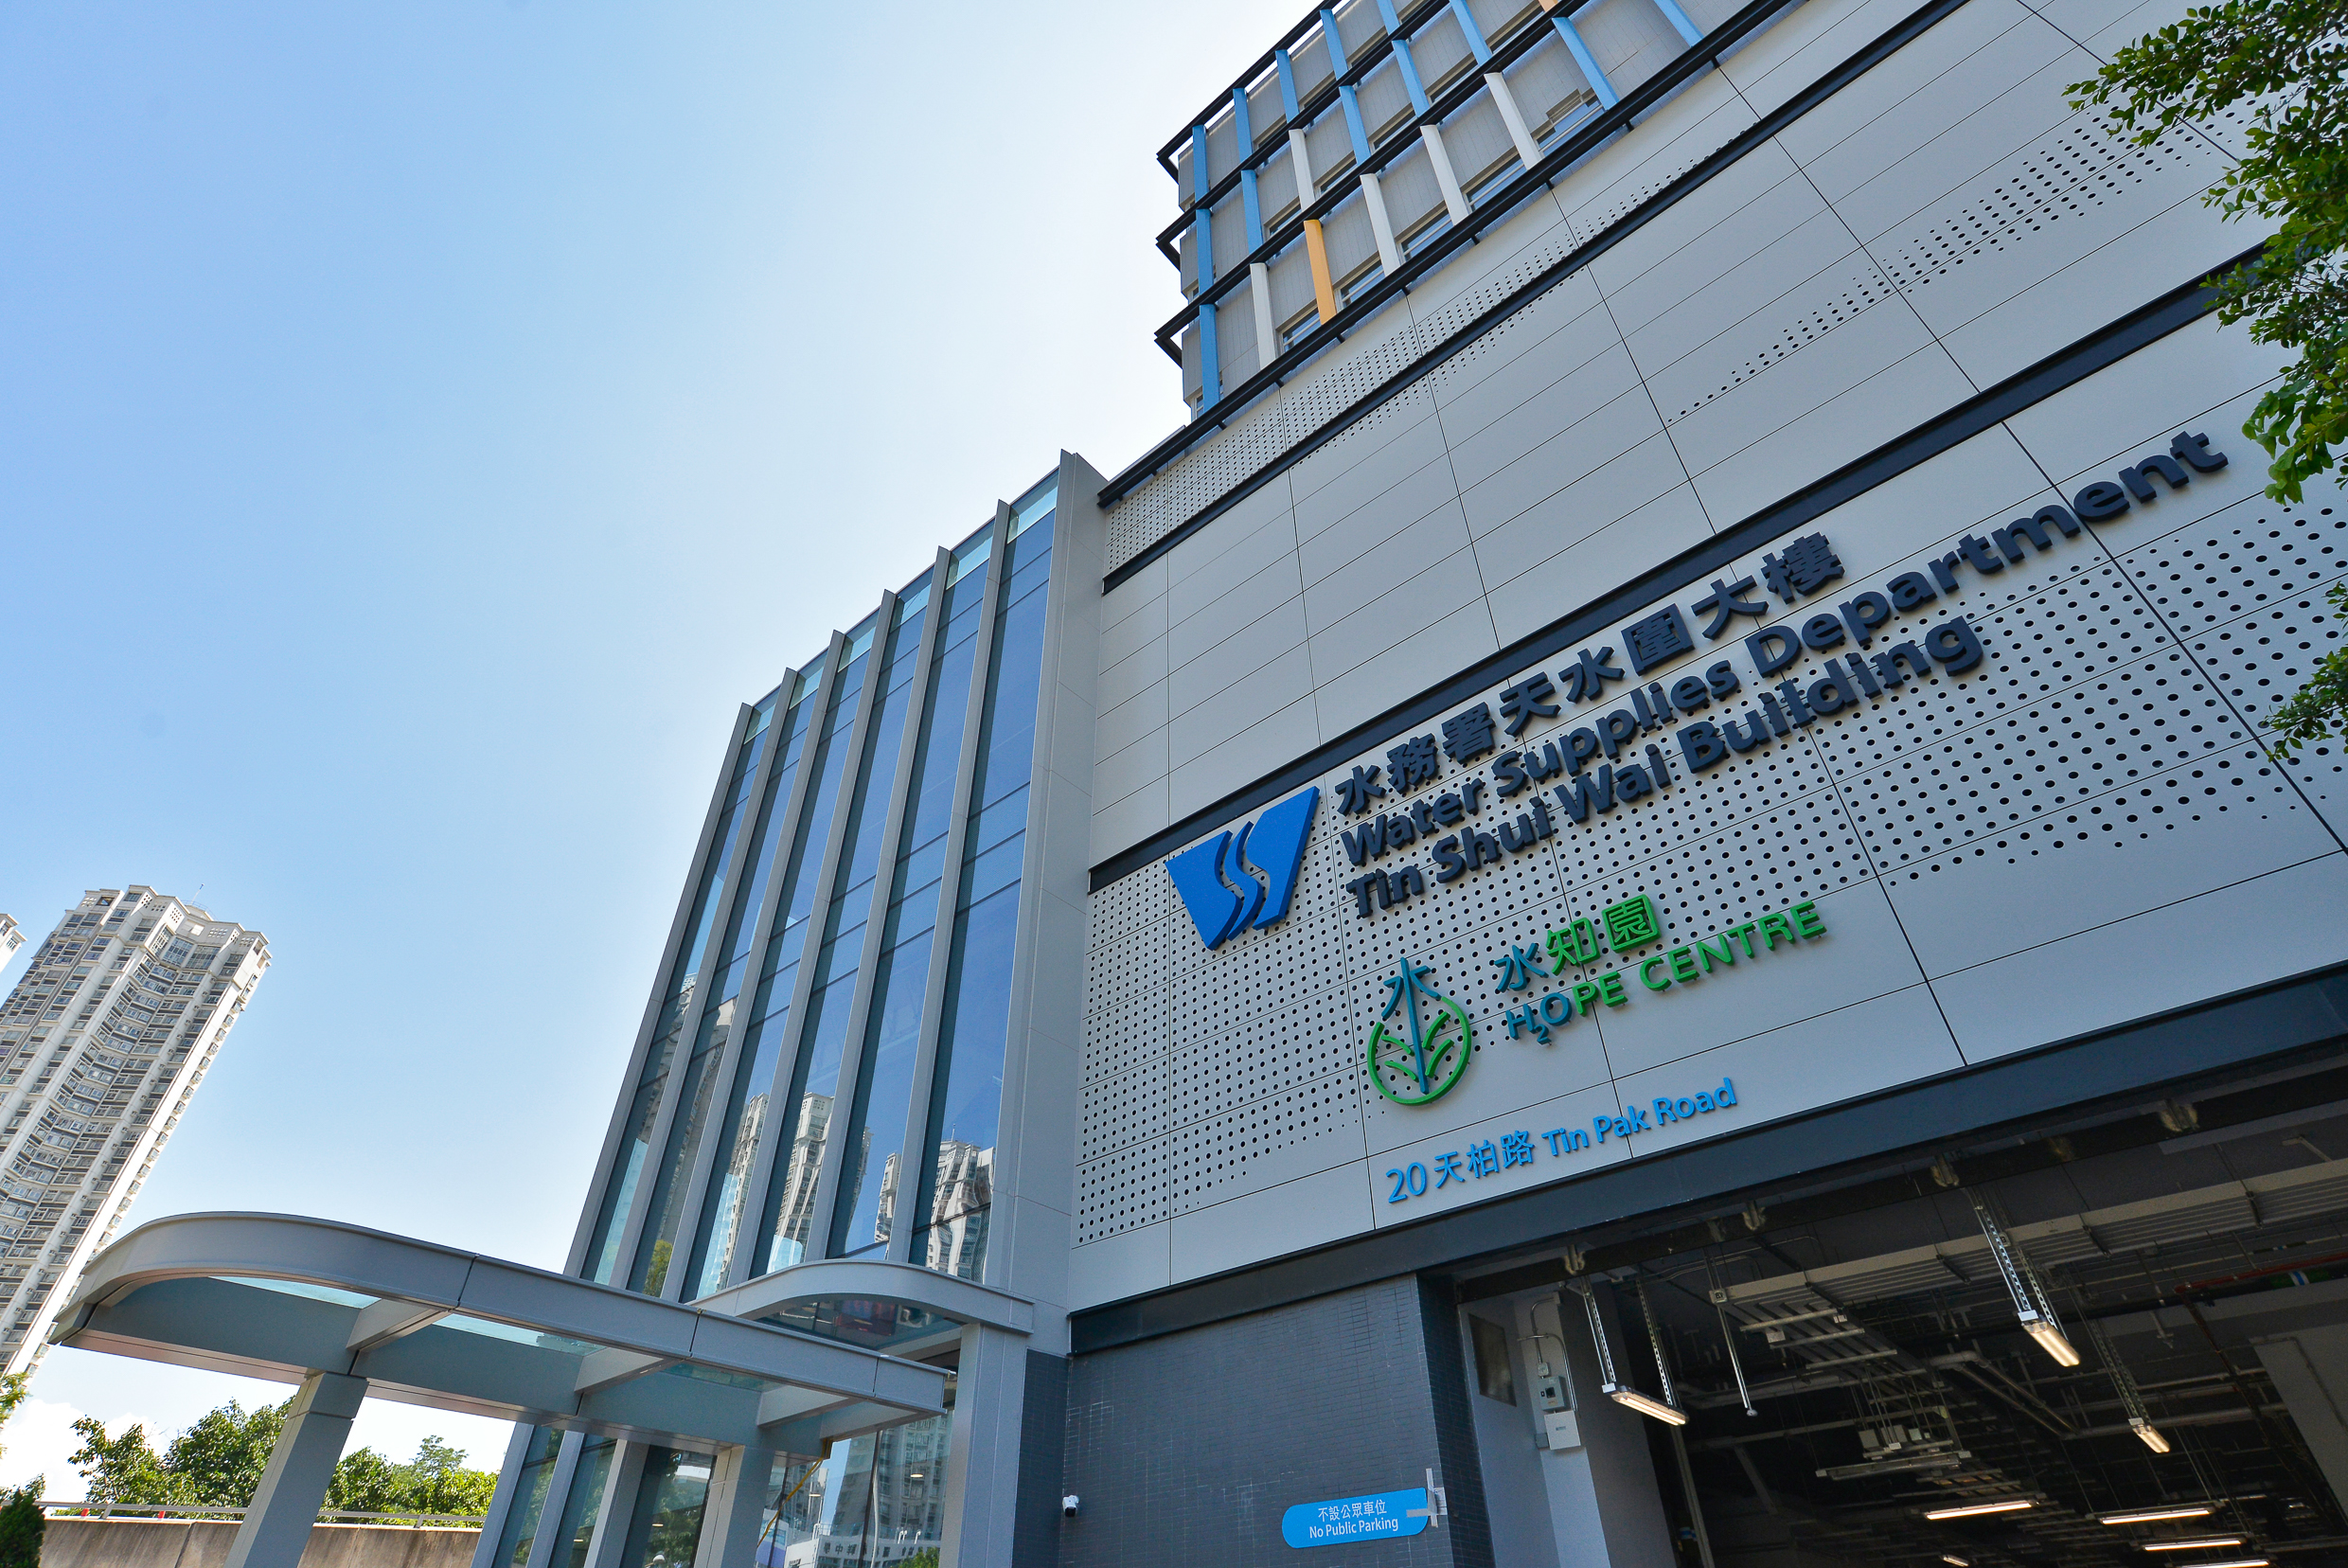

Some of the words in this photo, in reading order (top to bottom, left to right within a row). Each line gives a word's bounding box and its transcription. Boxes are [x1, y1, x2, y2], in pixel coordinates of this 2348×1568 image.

[1334, 531, 1846, 817] 水務署天水圍大樓
[1341, 776, 1485, 866] Water
[1492, 659, 1740, 797] Supplies
[1744, 430, 2229, 678] Department
[1345, 864, 1424, 918] Tin
[1431, 796, 1555, 883] Shui
[1553, 743, 1674, 825] Wai
[1676, 615, 1986, 774] Building
[1494, 894, 1662, 992] 水知園
[1640, 900, 1827, 992] CENTRE
[1541, 1128, 1590, 1157] Tin
[1592, 1105, 1652, 1144] Pak
[1652, 1077, 1737, 1125] Road
[1309, 1526, 1324, 1539] No
[1325, 1522, 1357, 1537] Public
[1359, 1517, 1398, 1532] Parking
[1318, 1499, 1387, 1523] 不設公眾車位
